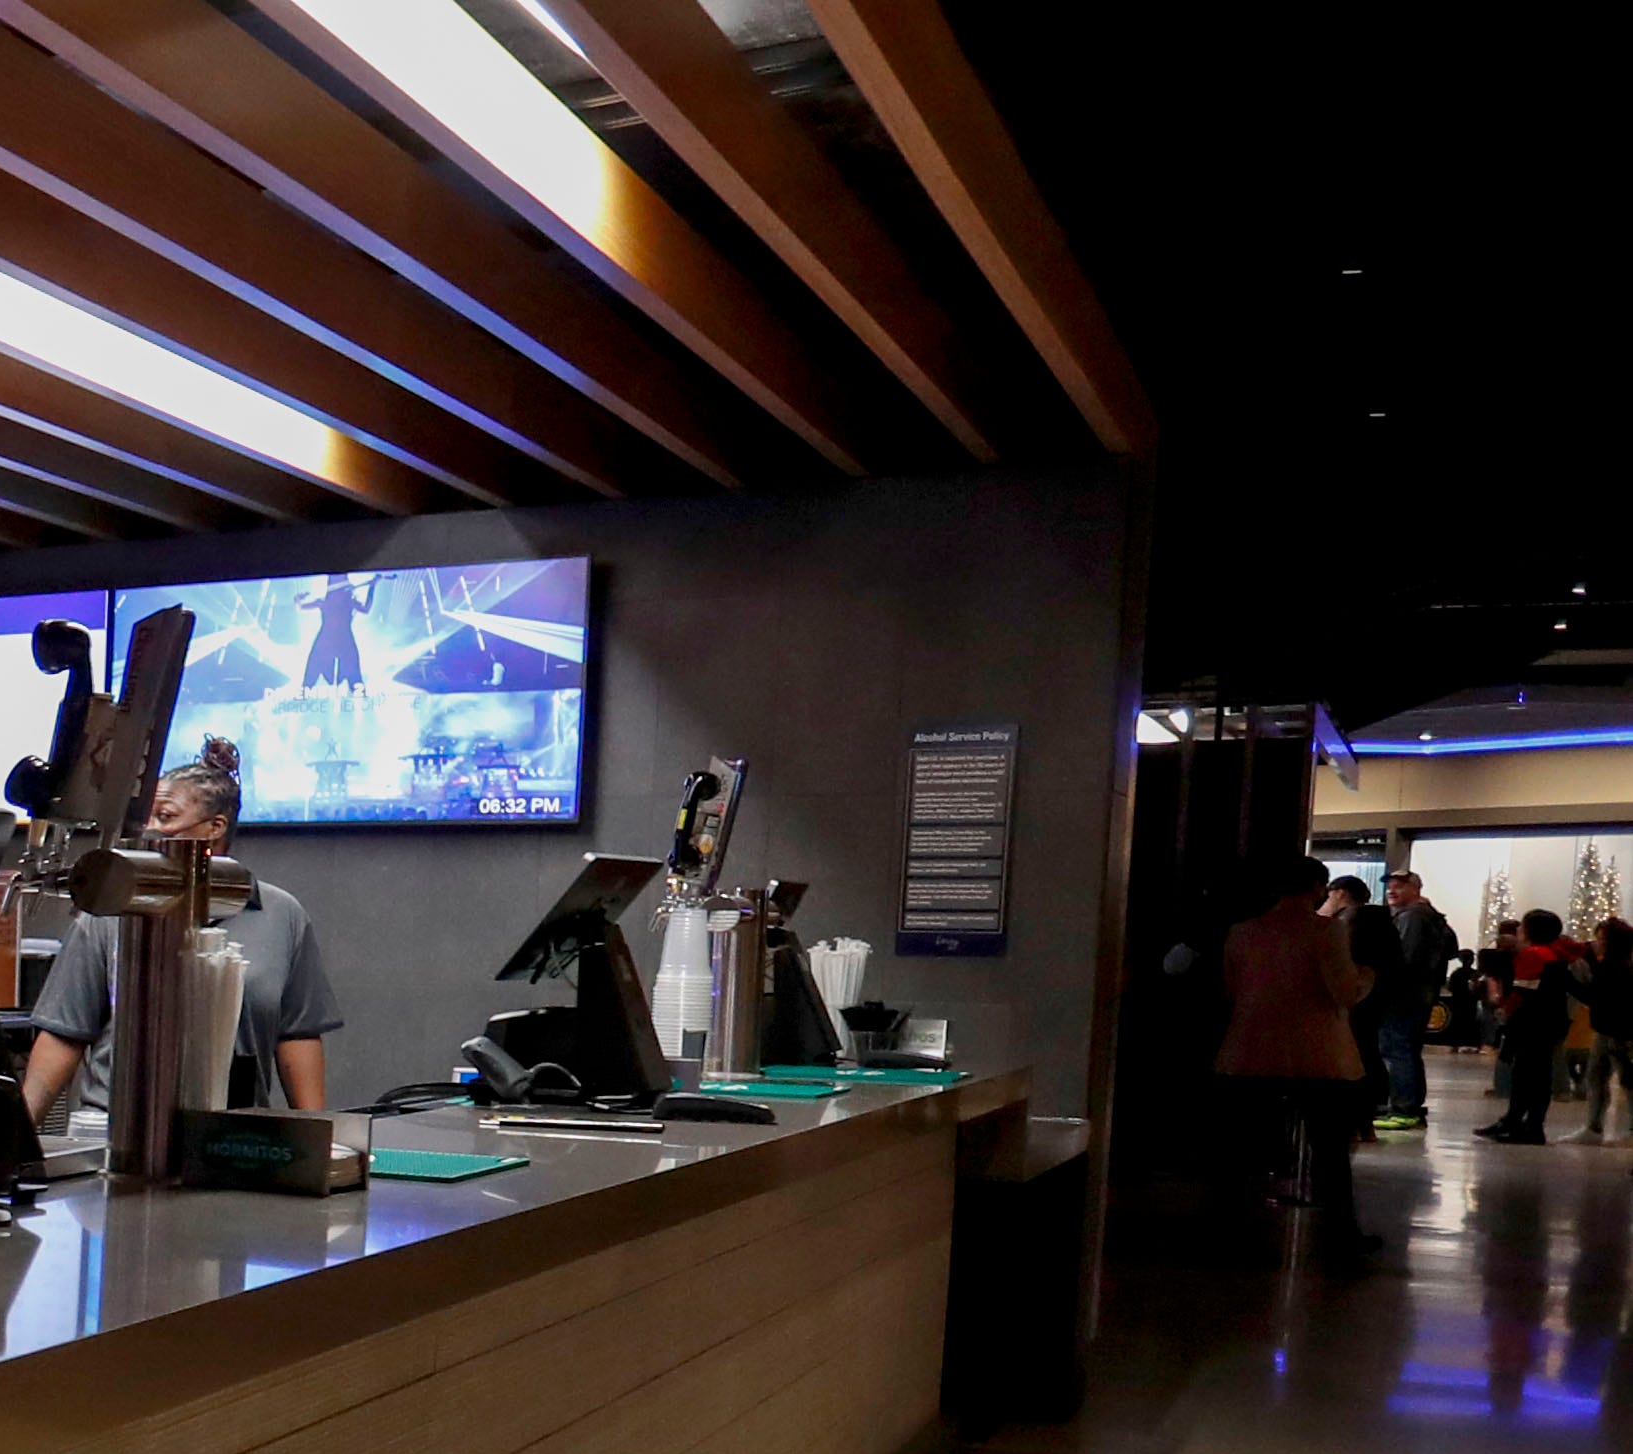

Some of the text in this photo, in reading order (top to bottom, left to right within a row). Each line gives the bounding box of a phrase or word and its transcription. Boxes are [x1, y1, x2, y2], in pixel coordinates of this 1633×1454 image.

[948, 732, 982, 742] Service
[982, 730, 1011, 742] Policy
[478, 797, 561, 814] 06:32 PM
